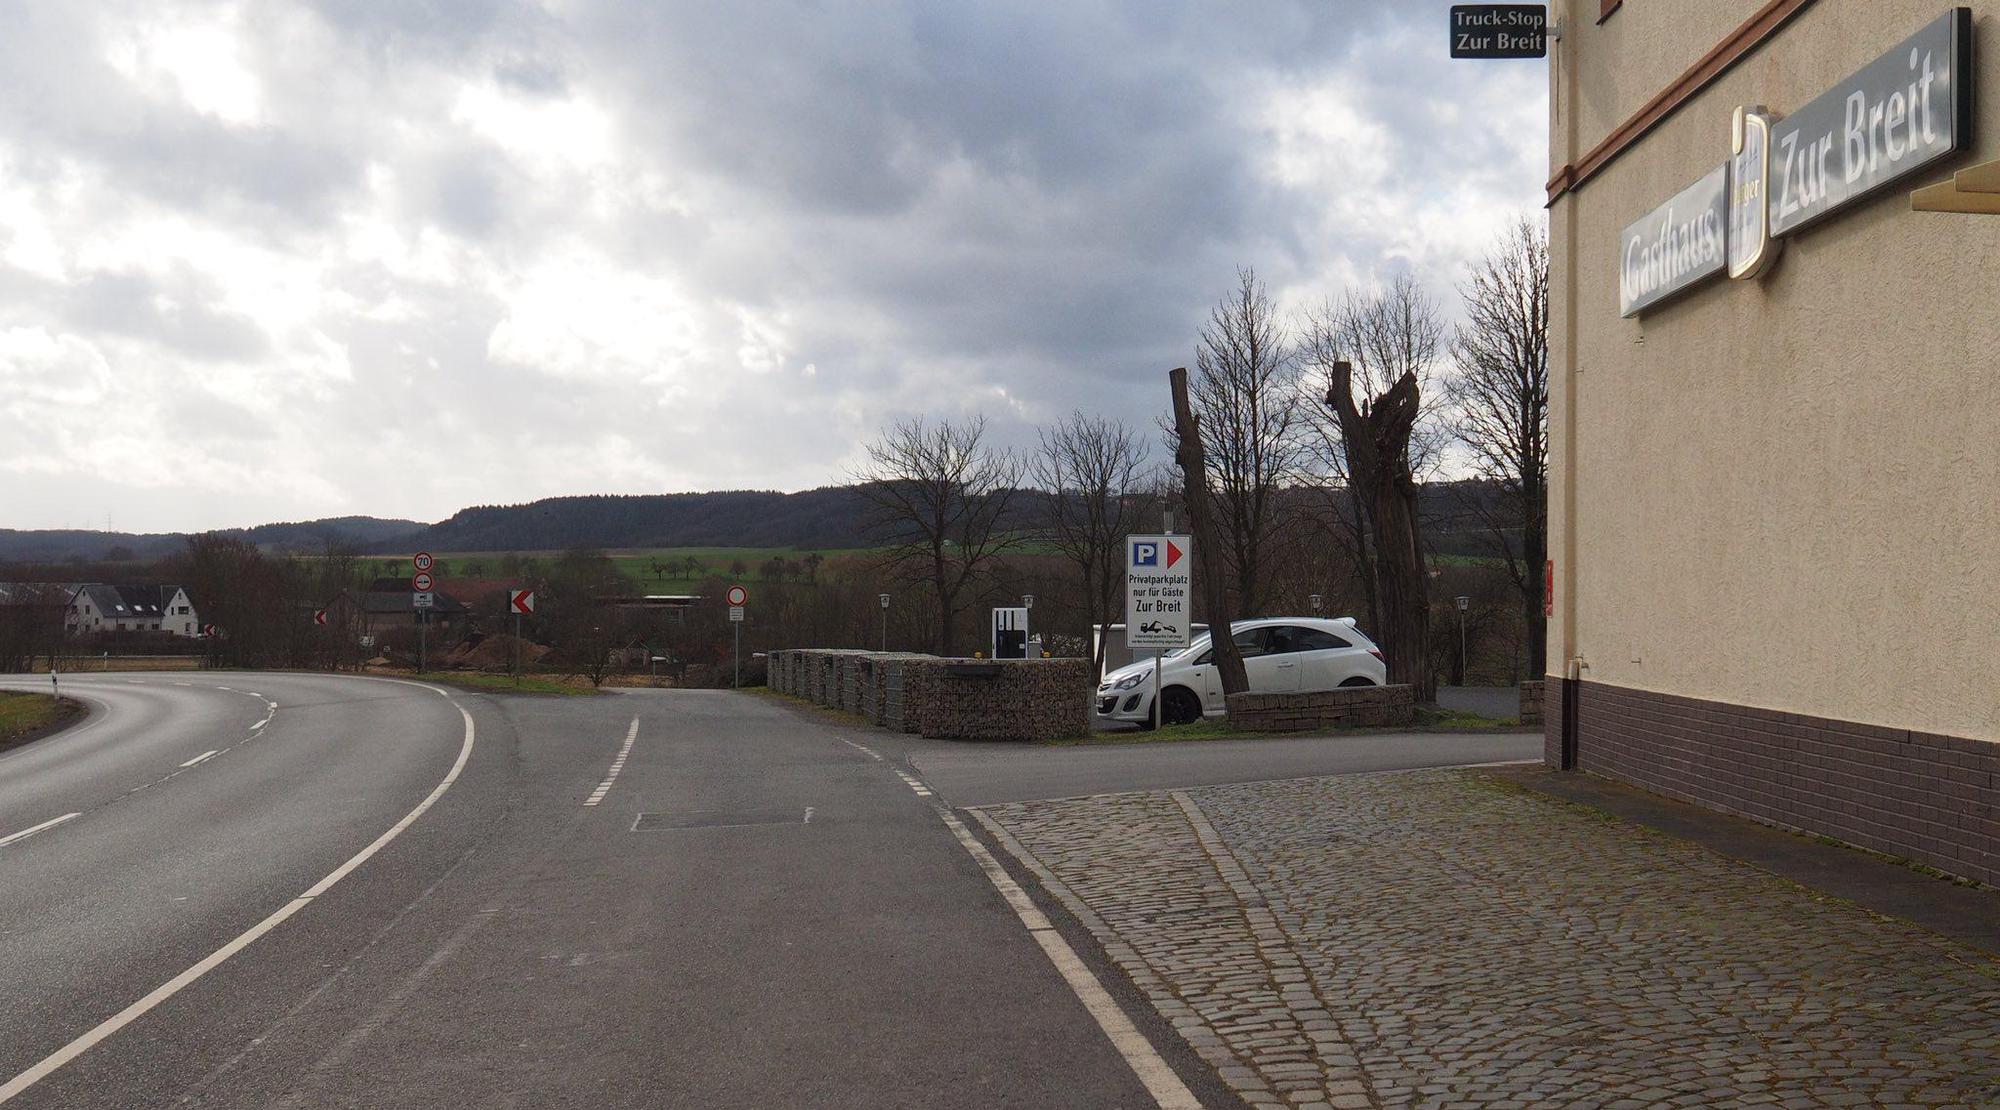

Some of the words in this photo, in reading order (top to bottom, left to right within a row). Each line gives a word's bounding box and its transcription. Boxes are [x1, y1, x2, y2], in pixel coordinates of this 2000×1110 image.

[1455, 10, 1543, 29] Truck-Stop
[1457, 33, 1491, 50] Zur
[1497, 32, 1542, 50] Breit
[1780, 127, 1832, 220] Zur
[1844, 47, 1936, 186] Breit
[1625, 207, 1715, 302] Gasthaus
[418, 557, 428, 566] 70
[1138, 545, 1155, 563] P
[1129, 574, 1188, 586] Privatparkplatz
[1133, 589, 1146, 597] nur
[1148, 587, 1160, 597] für
[1162, 587, 1184, 597] Gäste
[1136, 600, 1153, 612] Zur
[1156, 600, 1182, 612] Breit
